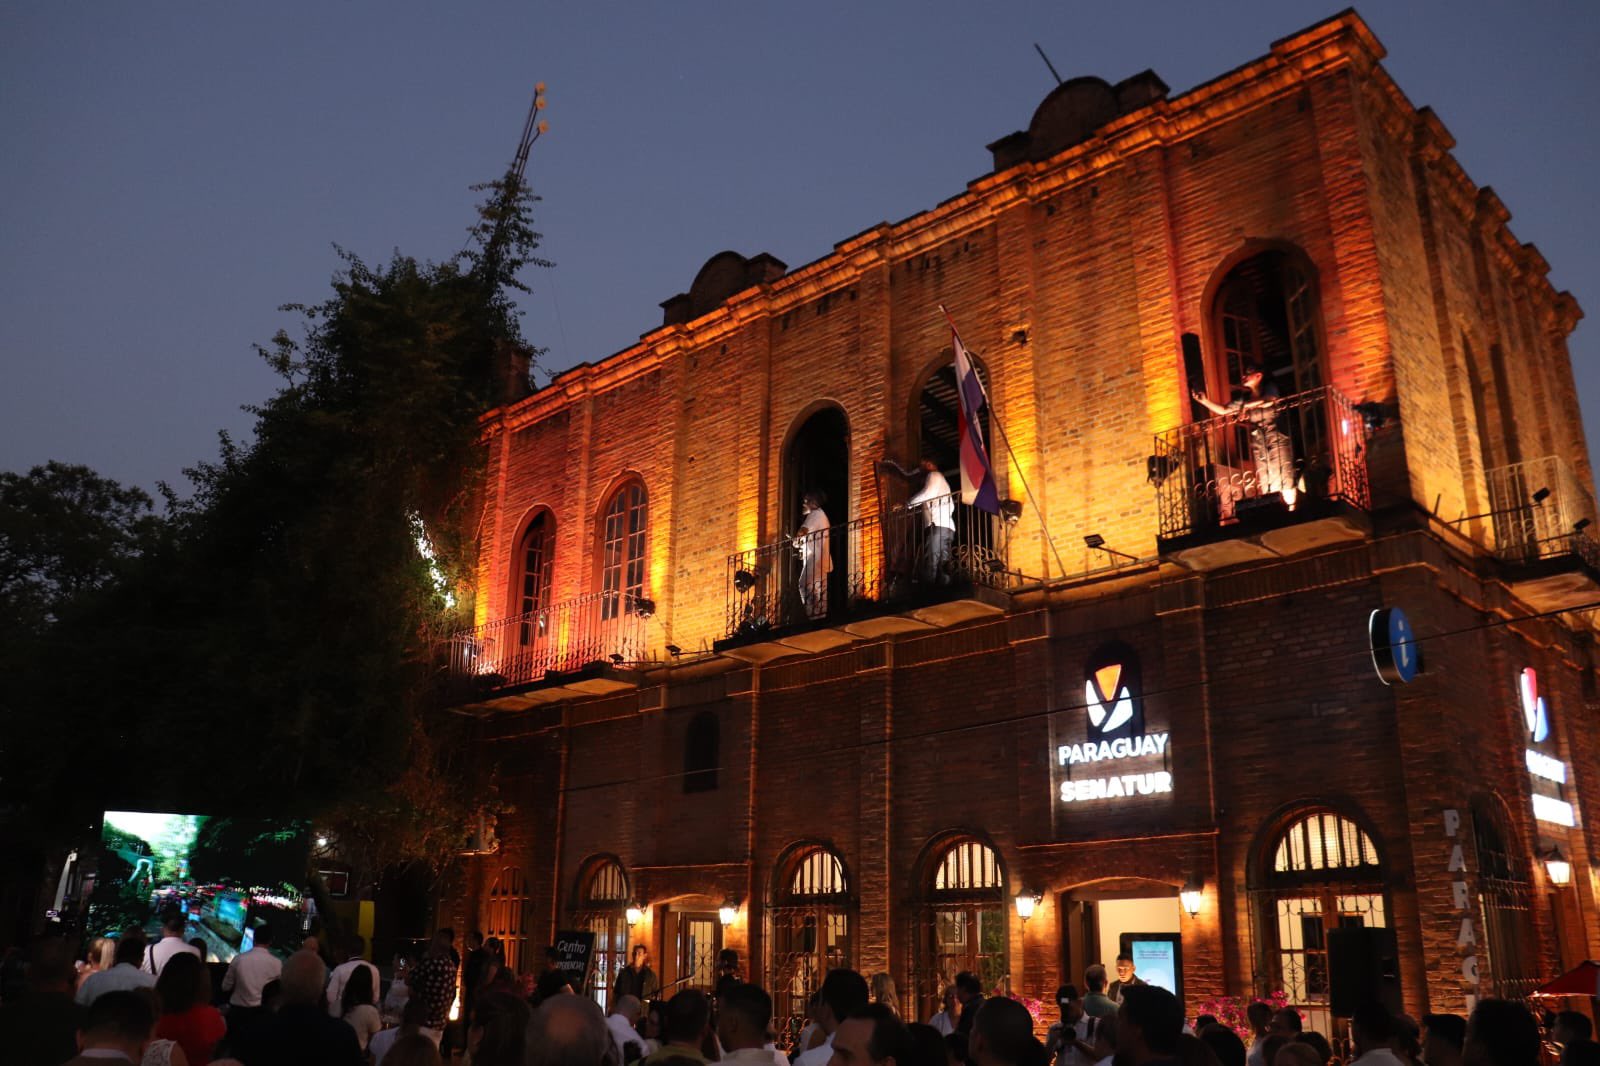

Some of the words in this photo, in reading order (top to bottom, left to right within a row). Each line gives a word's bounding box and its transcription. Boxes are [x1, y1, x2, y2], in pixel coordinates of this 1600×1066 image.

[1058, 733, 1168, 766] PARAGUAY
[1060, 771, 1173, 802] SENATUR
[557, 939, 586, 954] Centro
